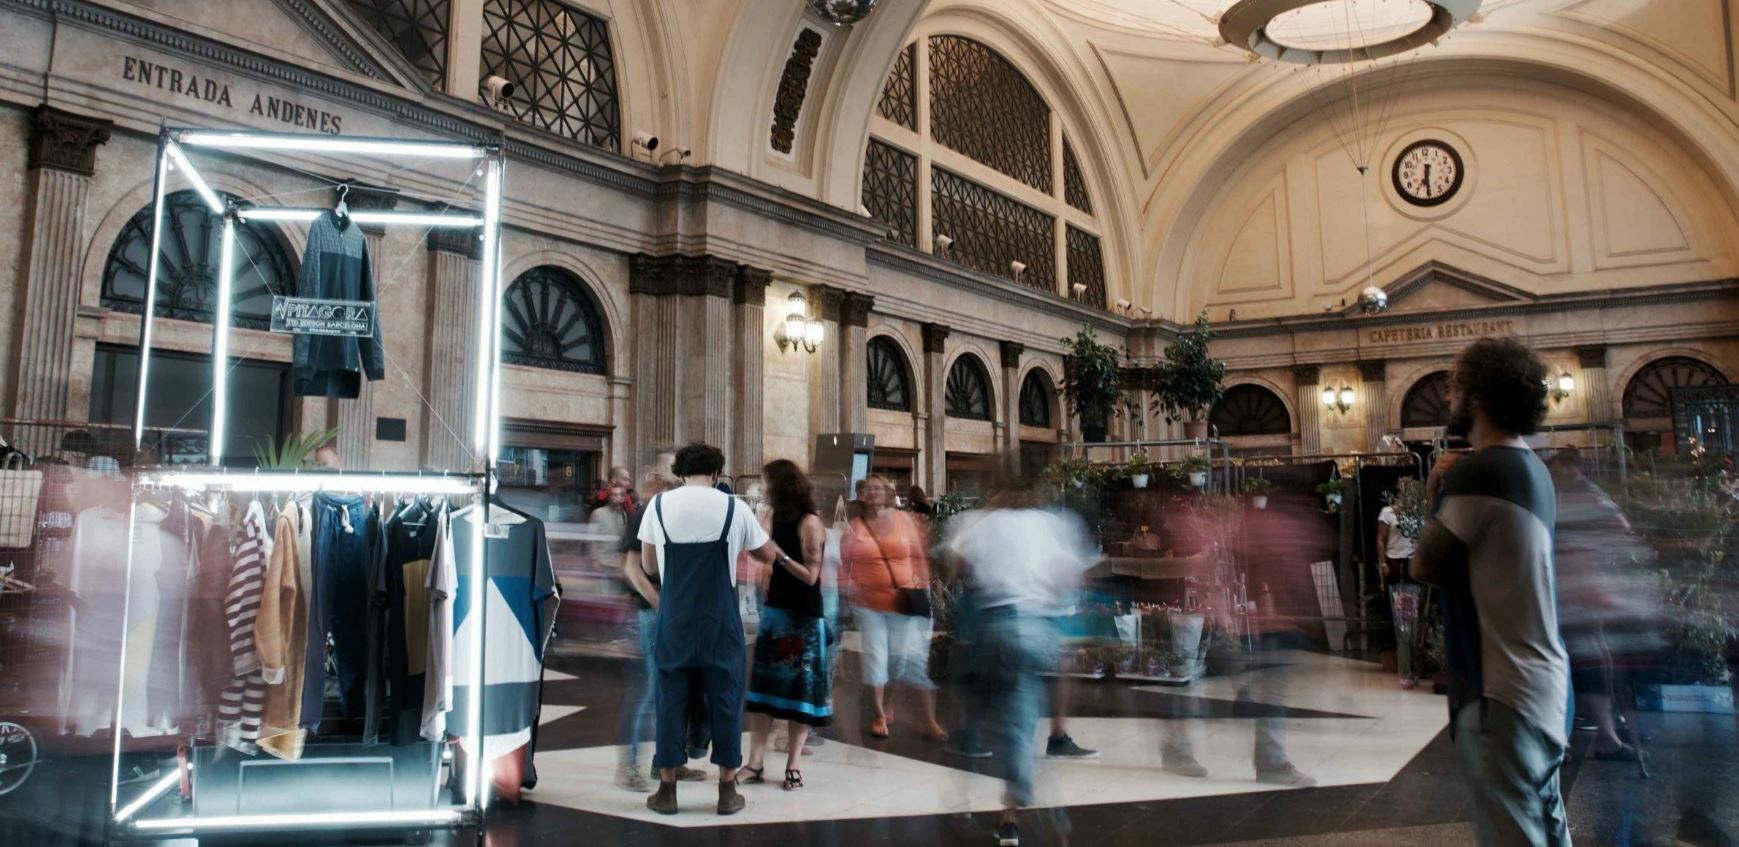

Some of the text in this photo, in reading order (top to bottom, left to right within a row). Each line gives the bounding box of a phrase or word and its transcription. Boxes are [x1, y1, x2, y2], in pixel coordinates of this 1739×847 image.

[122, 56, 342, 135] ENTRADA ANDENES
[1411, 151, 1418, 161] 11
[1421, 148, 1429, 156] 12
[1443, 156, 1448, 164] 2
[1405, 161, 1413, 169] 10
[1403, 171, 1409, 179] 9
[1444, 176, 1450, 184] 4
[300, 319, 326, 328] EDITION
[327, 321, 366, 330] BARCELONA
[1369, 320, 1512, 344] CAFETERIA RESTAURANT
[565, 466, 572, 477] 8
